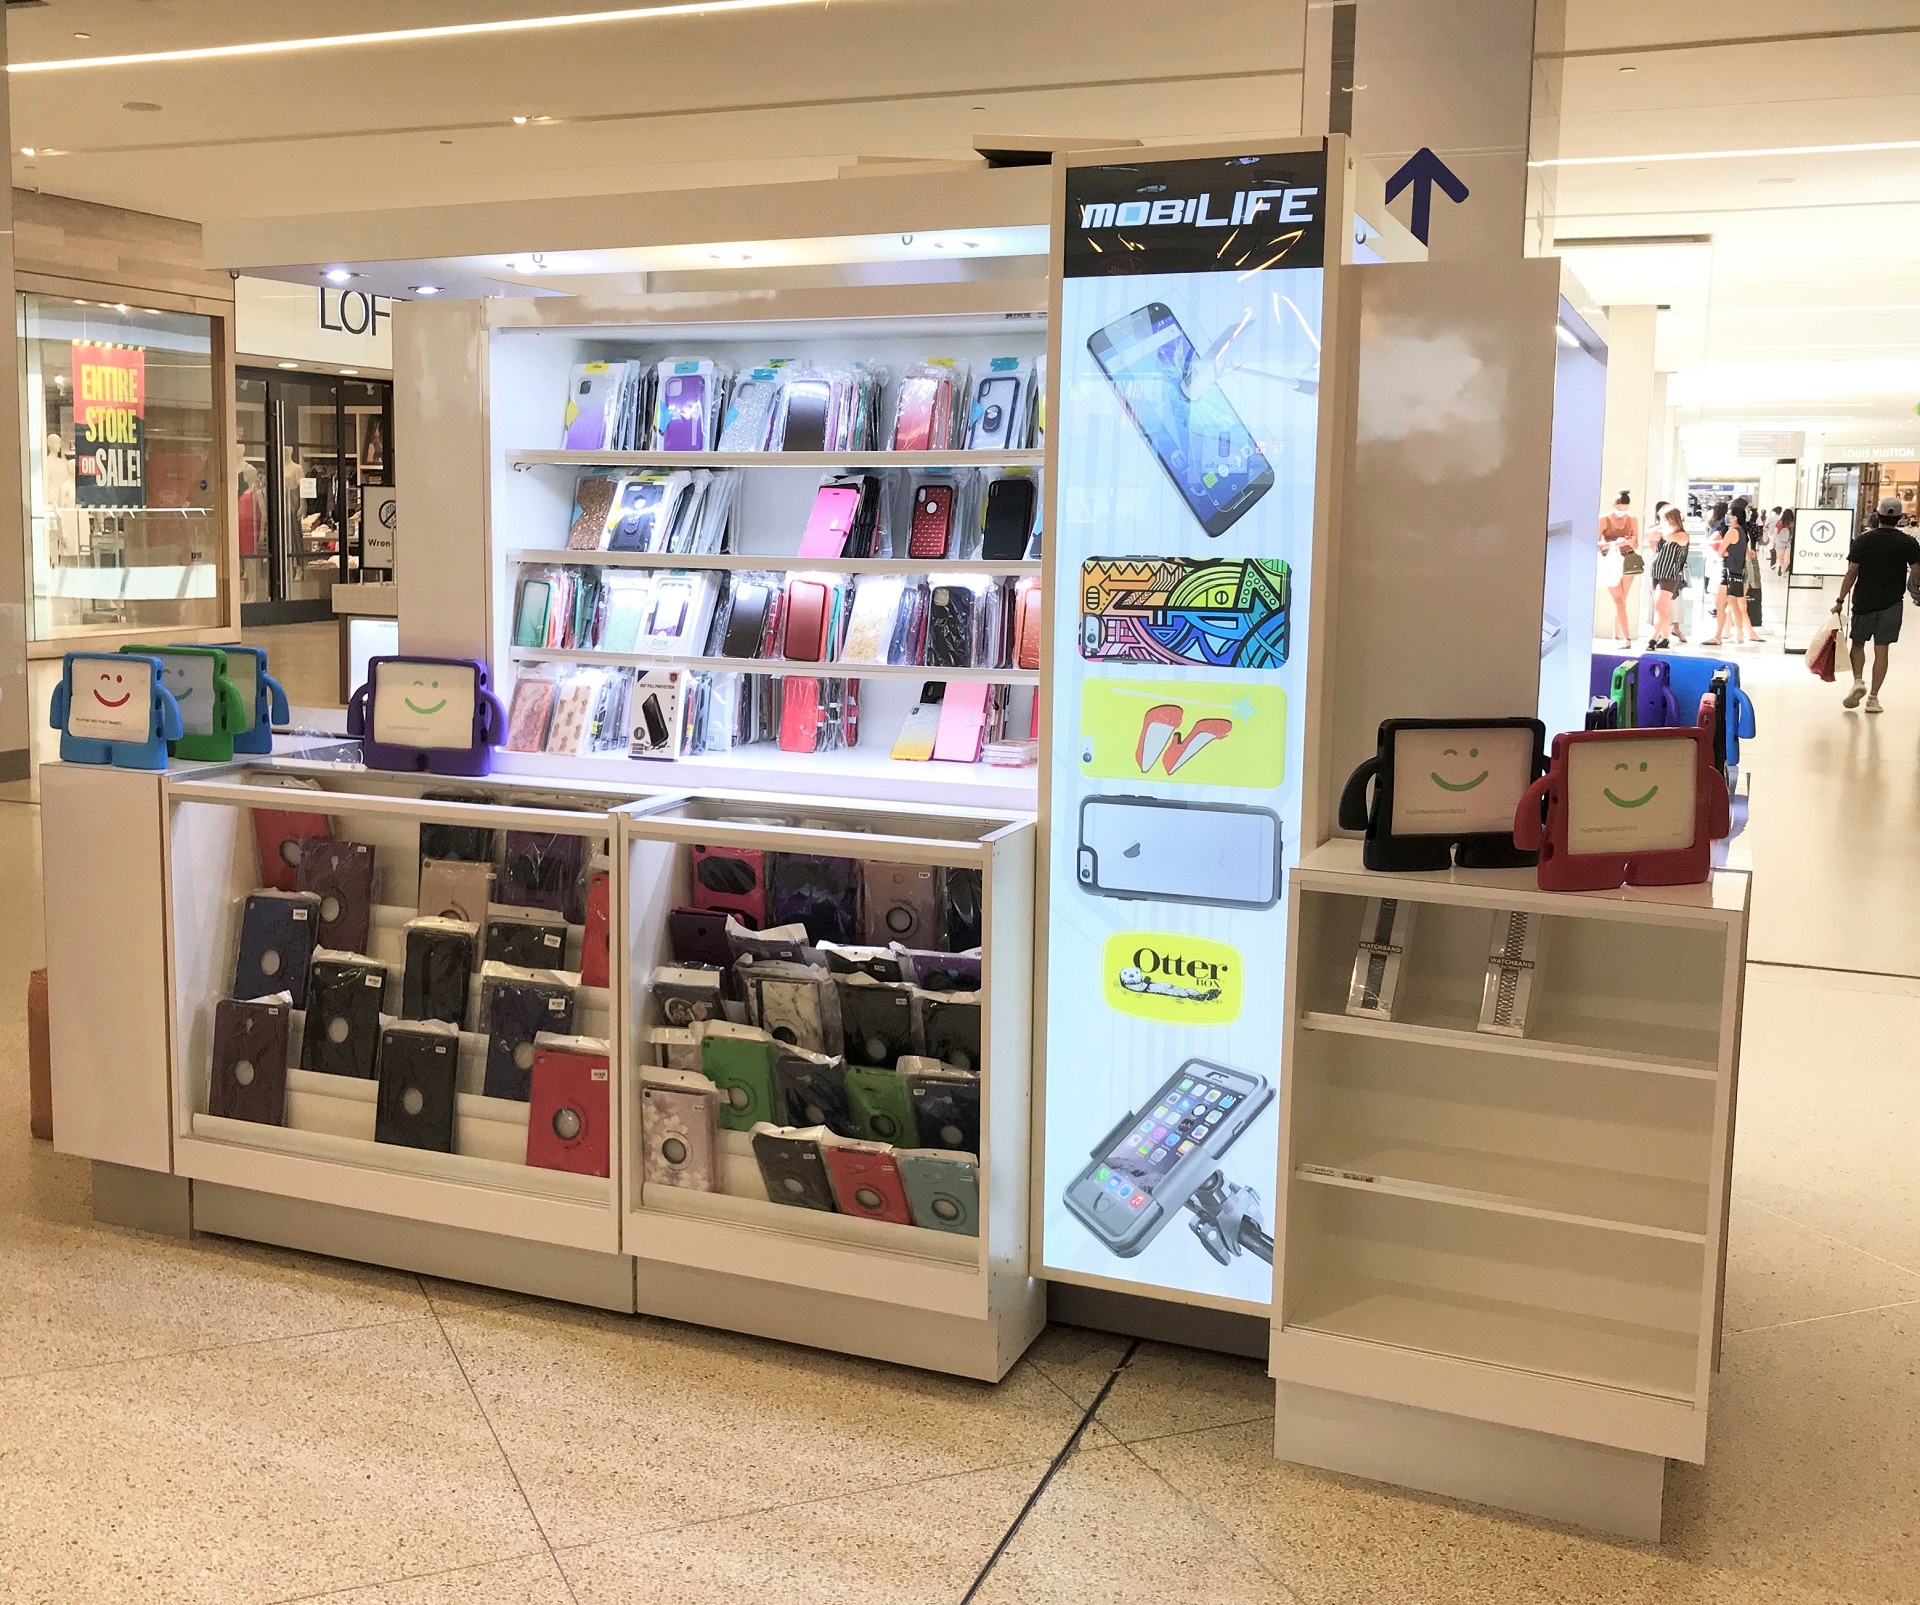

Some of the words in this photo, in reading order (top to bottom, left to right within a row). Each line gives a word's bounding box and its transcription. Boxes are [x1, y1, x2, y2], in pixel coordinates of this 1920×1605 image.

[1081, 187, 1318, 228] MOBILIFE
[320, 286, 392, 336] LOF
[81, 364, 138, 403] ENTIRE
[85, 406, 137, 444] STORE
[81, 455, 96, 474] on
[95, 448, 141, 487] SALE!
[1843, 448, 1870, 458] LOUIS
[1872, 447, 1915, 458] VUITTON
[1799, 549, 1820, 558] One
[1823, 551, 1845, 561] way
[1133, 947, 1228, 980] Otter
[1196, 978, 1220, 988] BOX
